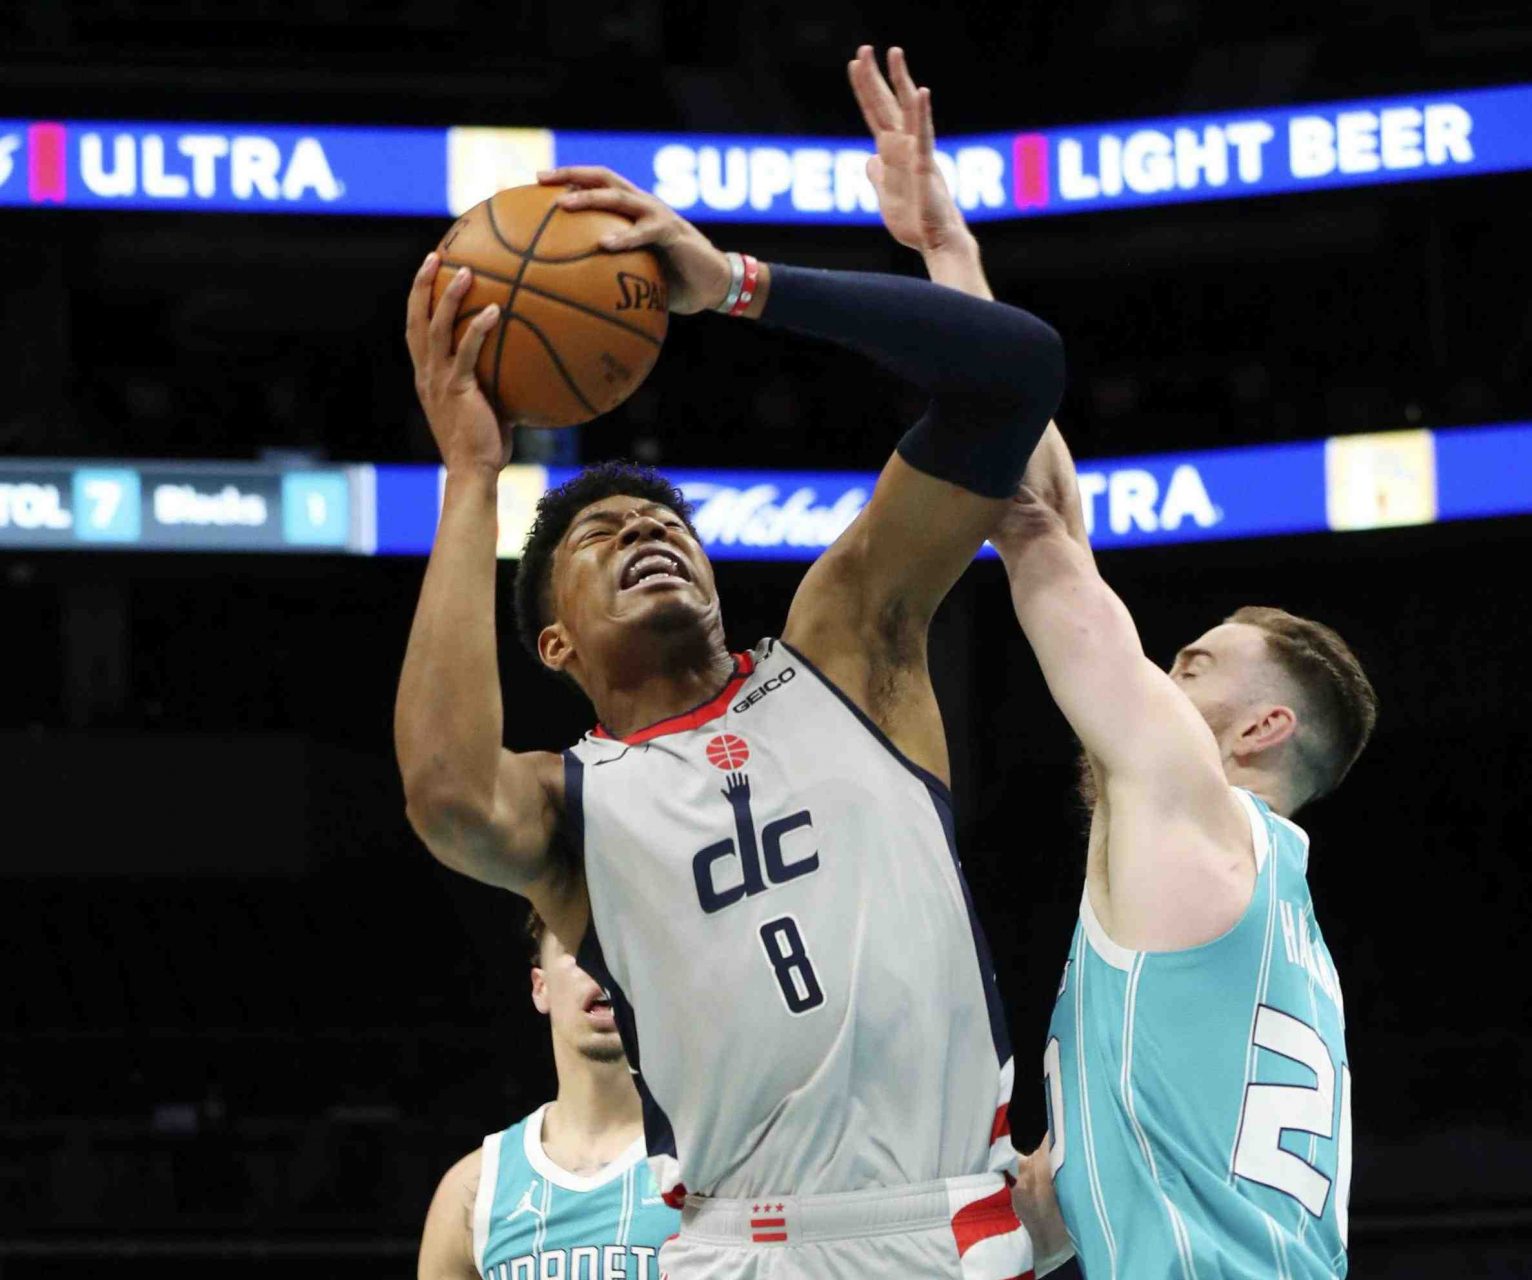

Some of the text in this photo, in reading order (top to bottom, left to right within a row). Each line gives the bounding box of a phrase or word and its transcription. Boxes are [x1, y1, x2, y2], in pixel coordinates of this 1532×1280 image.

[79, 132, 339, 201] ULTRA
[652, 103, 1474, 212] SUPERR LIGHT BEER
[85, 479, 121, 529] 7
[1076, 464, 1217, 536] TRA
[732, 666, 796, 714] GEICO
[692, 772, 820, 914] dc
[759, 915, 824, 1015] 8
